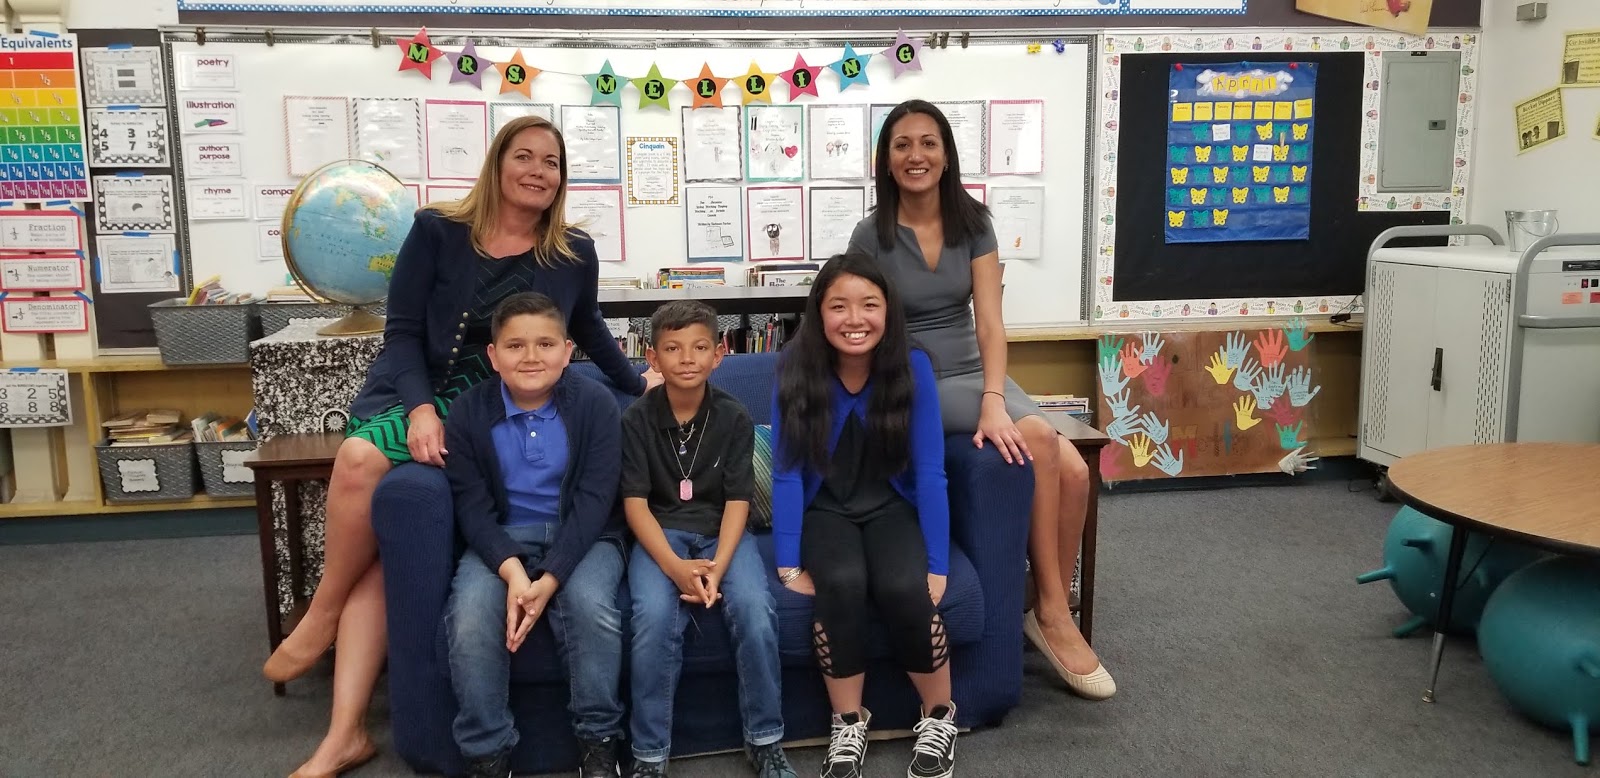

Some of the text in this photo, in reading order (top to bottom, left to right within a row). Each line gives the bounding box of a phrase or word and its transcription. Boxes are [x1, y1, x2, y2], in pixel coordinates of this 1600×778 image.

[1, 37, 73, 51] Equivalents
[9, 57, 14, 65] 1
[197, 58, 229, 67] poetry
[409, 44, 524, 84] MRS.
[597, 45, 912, 98] MELLING
[40, 74, 50, 86] 1/2
[186, 101, 235, 109] illustration
[29, 111, 40, 122] 1/4
[60, 111, 71, 122] 1/4
[15, 129, 75, 141] 1/5 1/5 1/5
[100, 129, 108, 138] 4
[128, 128, 135, 138] 3
[101, 141, 109, 151] 5
[129, 141, 136, 151] 7
[199, 144, 229, 152] author's
[639, 143, 665, 151] Cinquain
[7, 147, 79, 160] 1/6 1/6 1/6 1/6
[200, 153, 230, 161] purpose
[12, 166, 23, 178] 1/8
[28, 166, 38, 178] 1/8
[43, 166, 53, 177] 1/8
[59, 166, 69, 177] 1/8
[74, 165, 84, 177] 1/8
[2, 184, 86, 196] 1/10 1/10 1/10 1/10 1/10 1/10 1/10
[204, 187, 231, 195] rhyme
[0, 388, 57, 399] 3 2 5
[1, 401, 59, 413] 8 8 8
